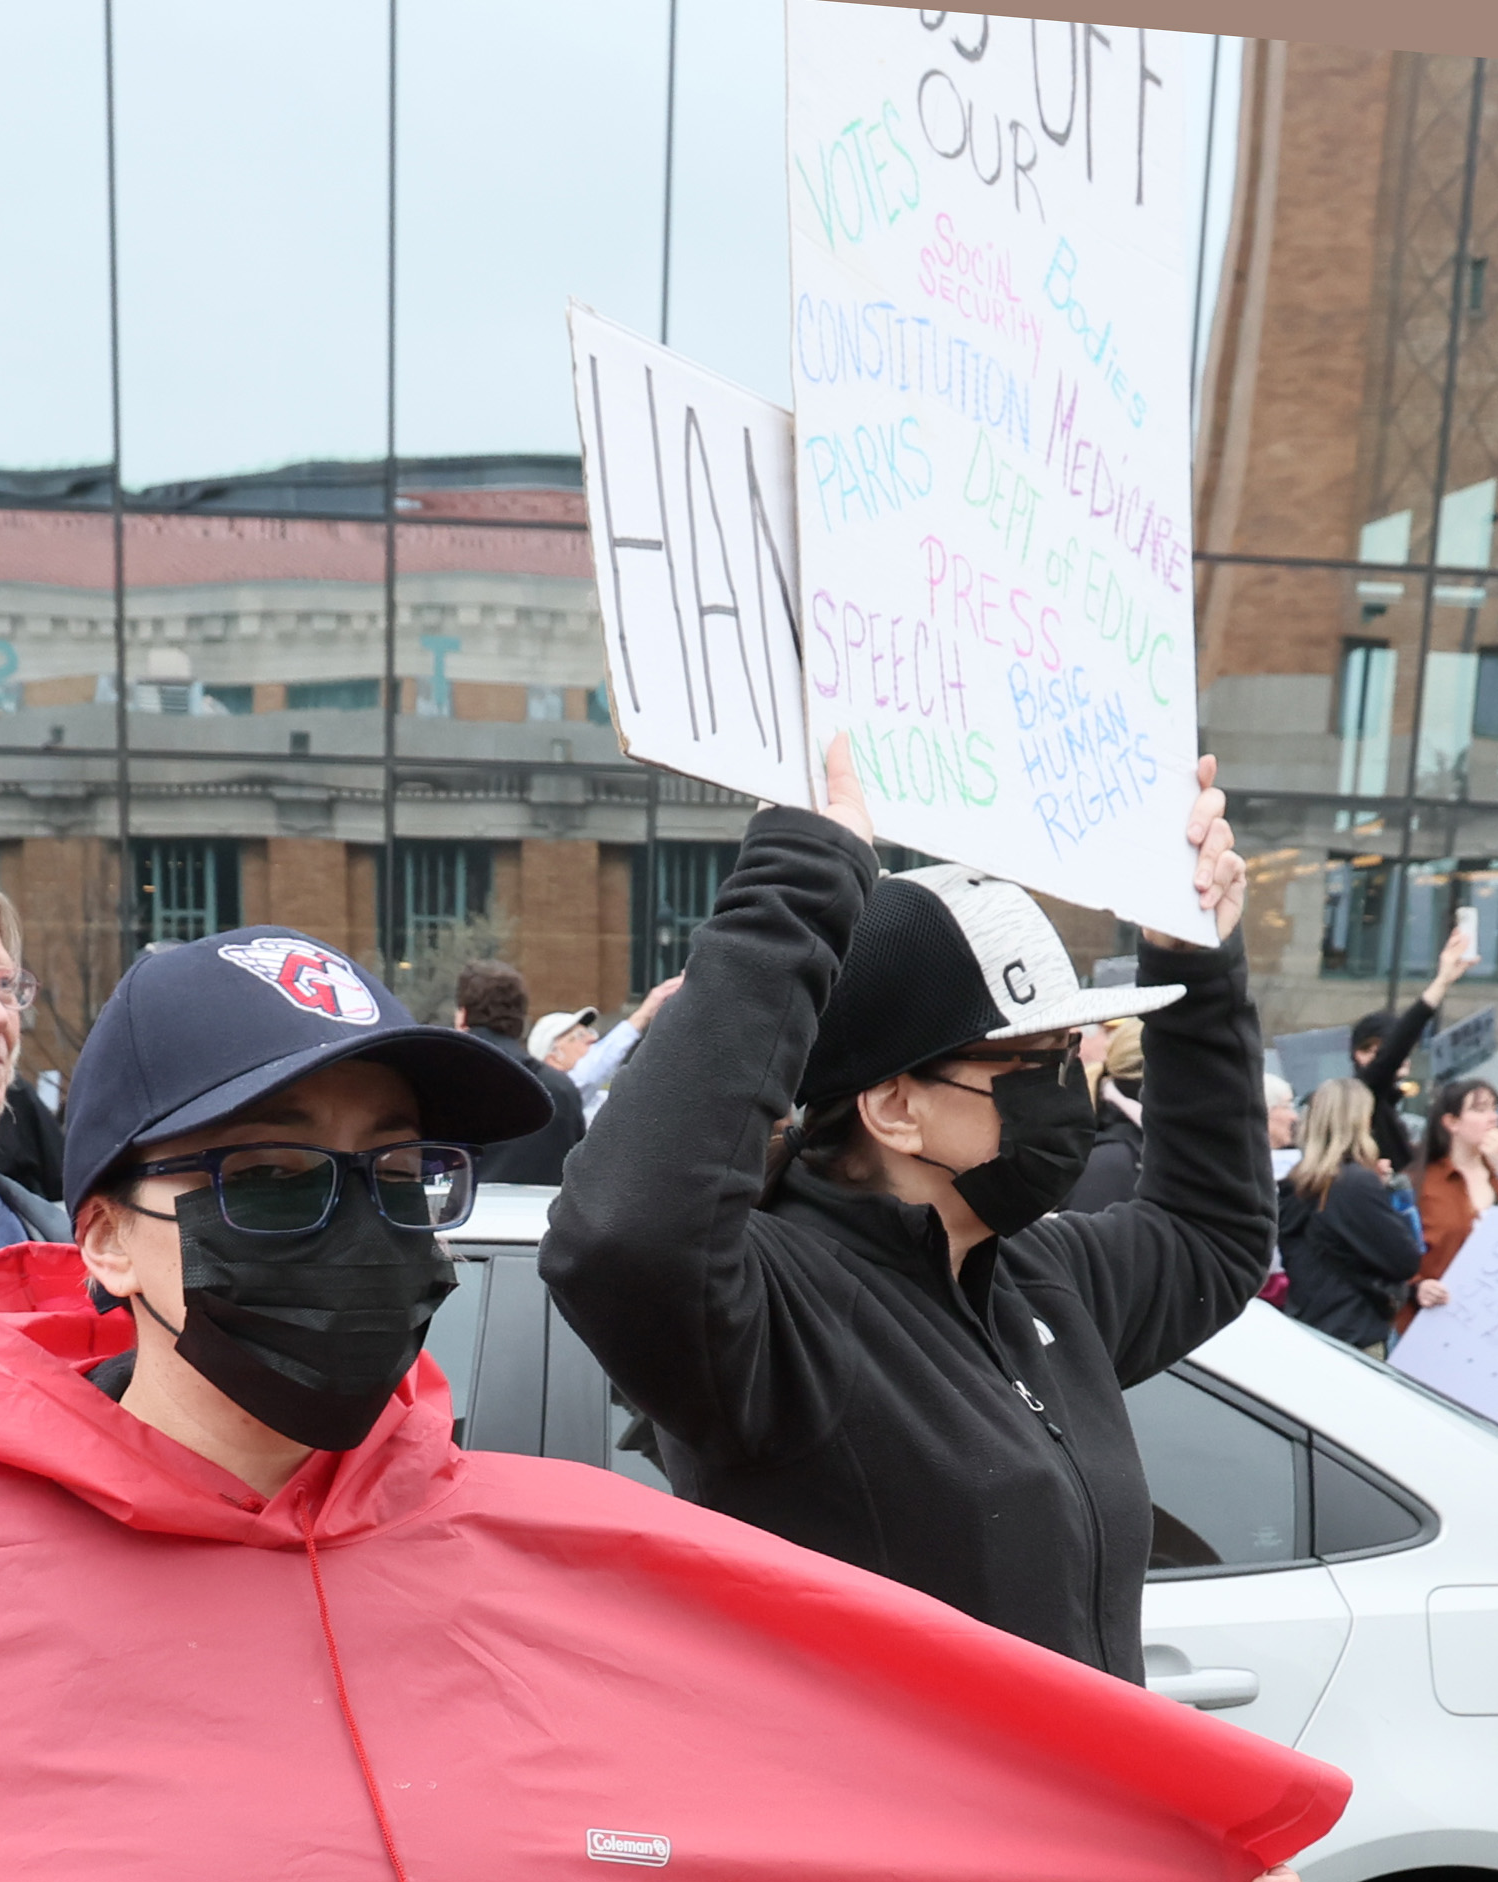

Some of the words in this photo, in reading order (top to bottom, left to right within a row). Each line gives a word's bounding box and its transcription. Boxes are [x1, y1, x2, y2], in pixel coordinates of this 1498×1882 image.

[795, 99, 920, 249] VOTES
[918, 68, 1045, 224] OUR
[798, 292, 1030, 453] CONSTITUTION
[805, 415, 932, 533] PARKS
[919, 535, 1060, 672] PRESS
[963, 426, 1044, 566] DEPT
[1084, 546, 1176, 706] EDUC
[813, 589, 967, 732] SPEECH
[1007, 661, 1091, 731] BASIC
[817, 721, 998, 808] NIONS
[1020, 690, 1130, 788] HUMAN
[1033, 733, 1158, 864] RIGHTS
[1002, 959, 1036, 1005] C
[592, 1833, 653, 1855] Coleman
